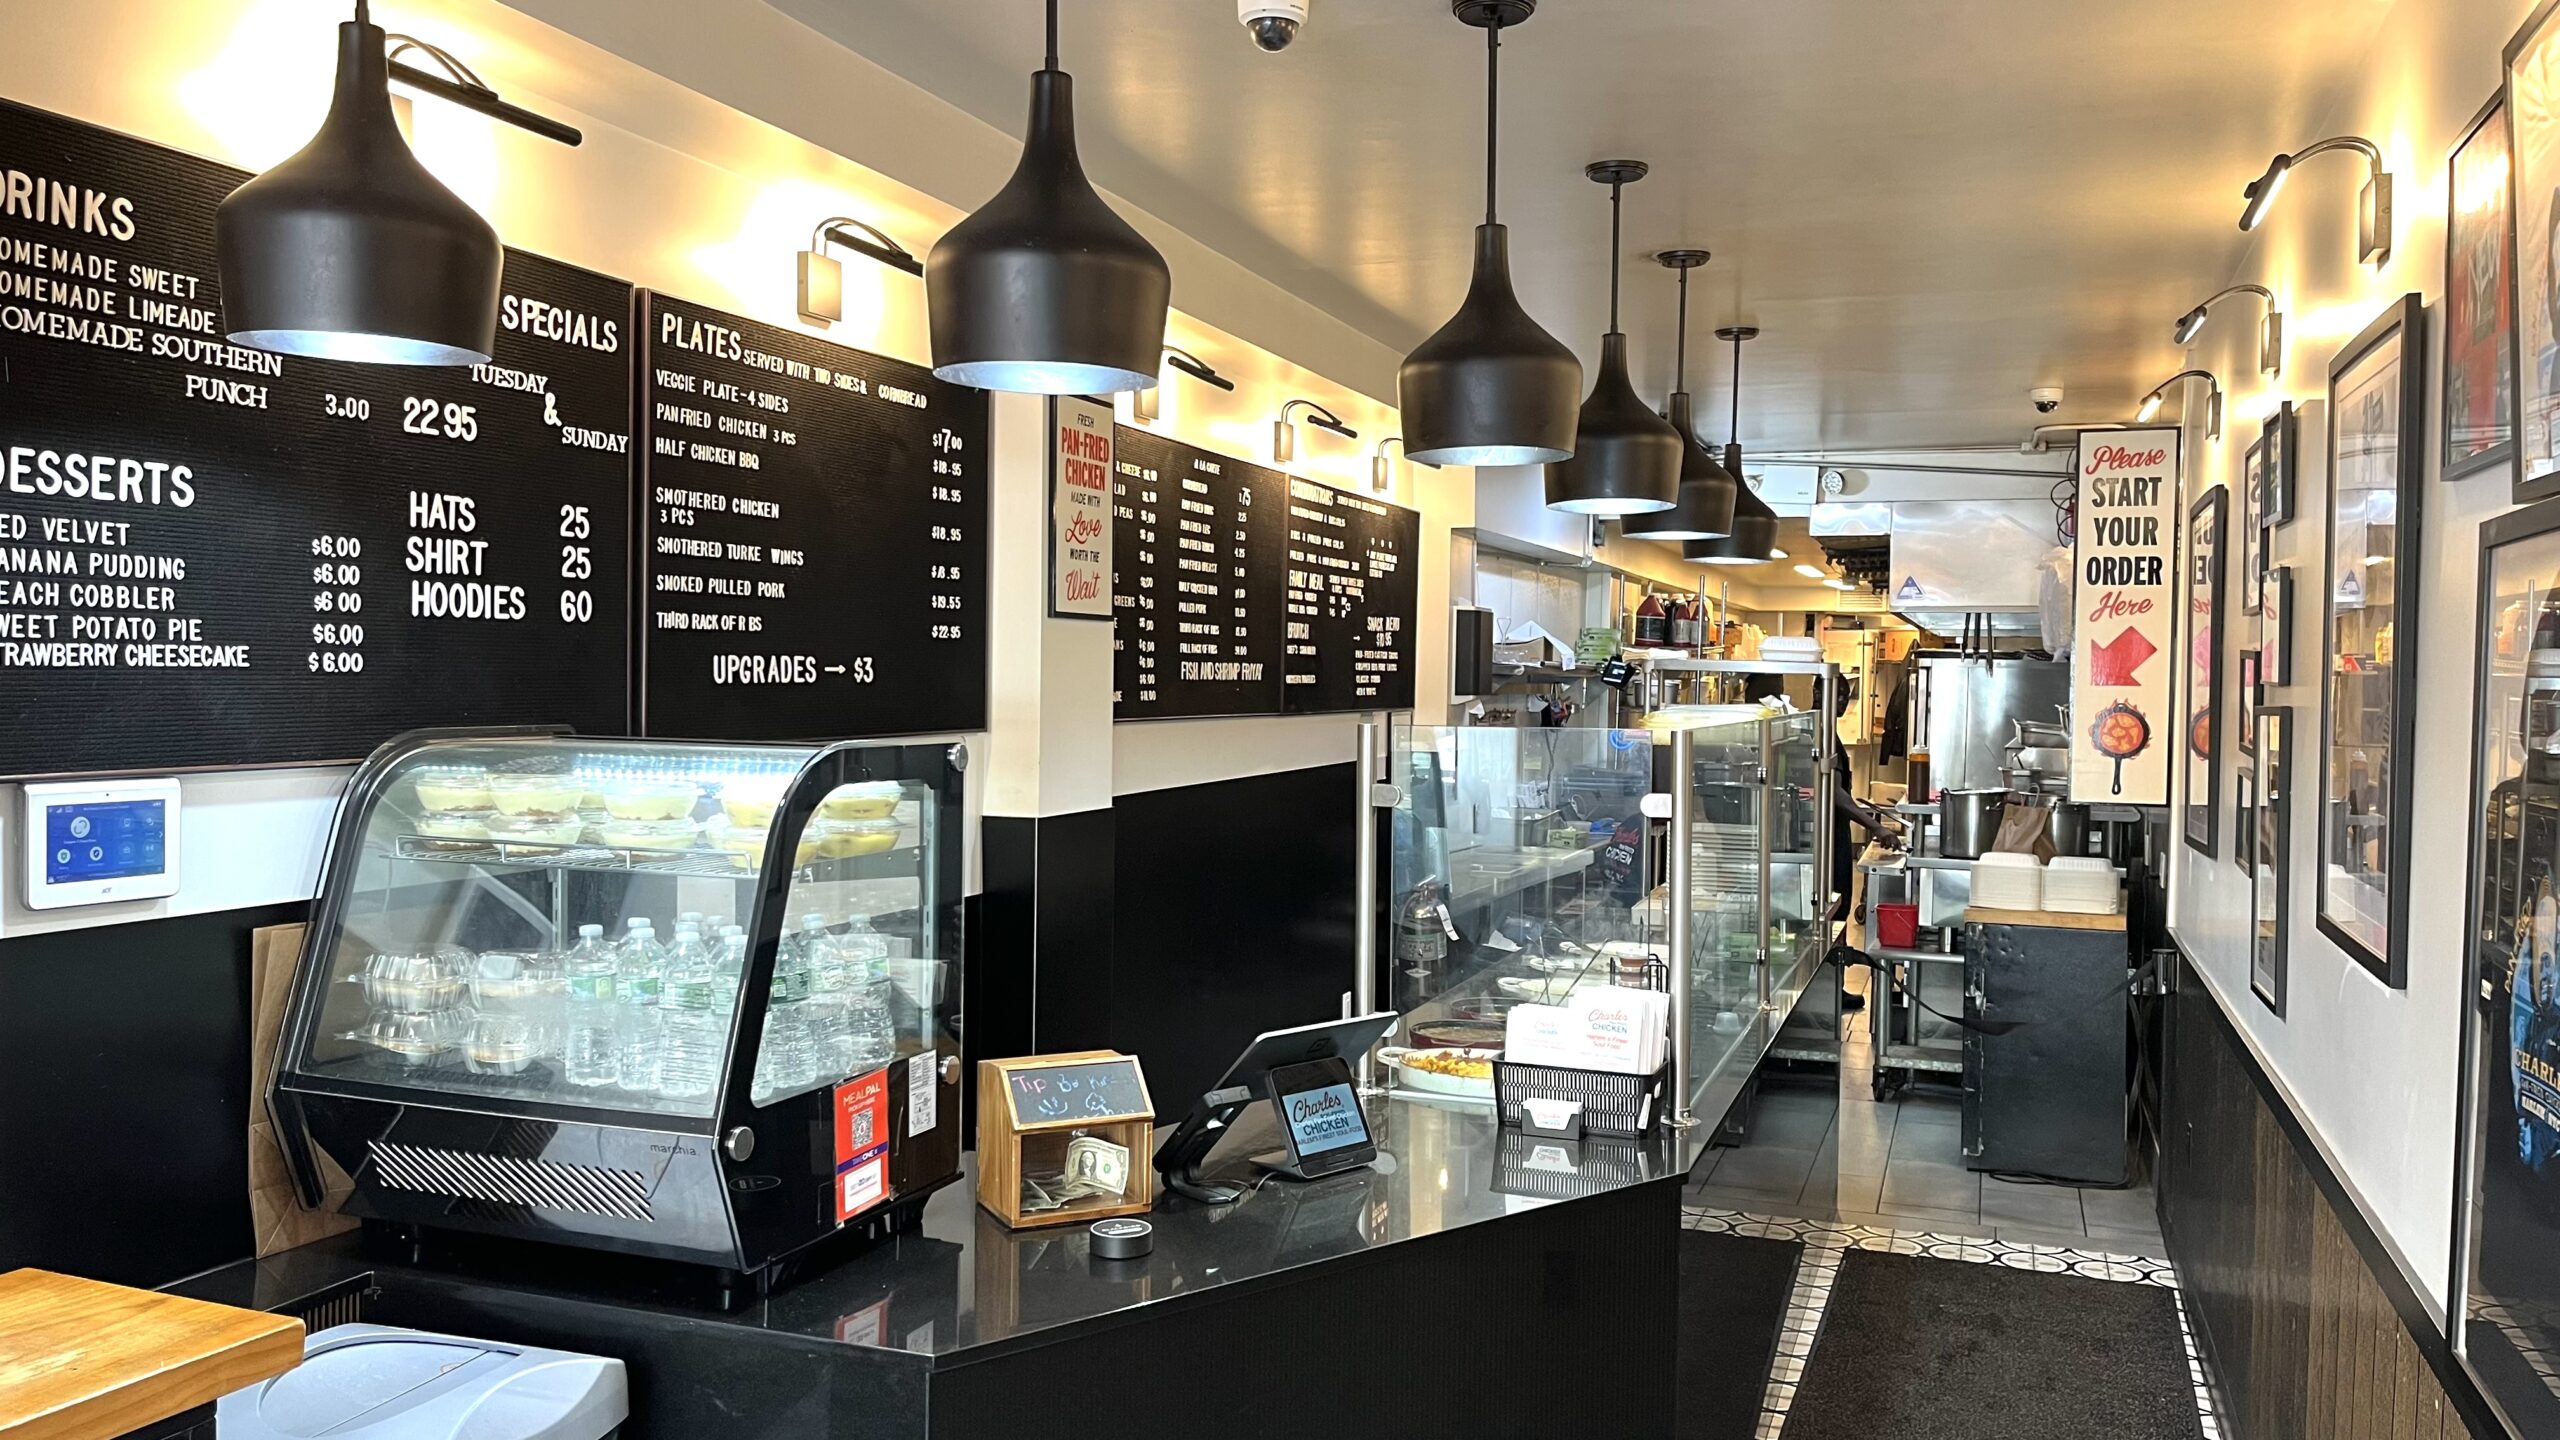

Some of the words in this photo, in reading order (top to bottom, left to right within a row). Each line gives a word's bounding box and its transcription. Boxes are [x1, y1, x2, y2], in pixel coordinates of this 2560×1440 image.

[0, 169, 136, 241] RINKS
[128, 264, 199, 300] SWEET
[128, 296, 216, 335] LIMEADE
[501, 294, 618, 353] SPECIALS
[0, 303, 144, 352] OMEMADE
[151, 333, 283, 377] SOUTHERN
[661, 313, 742, 361] PLATES
[743, 349, 784, 374] SERVED
[786, 359, 810, 381] WITH
[185, 374, 268, 409] PUNCH
[468, 362, 549, 395] TUESDAY
[656, 368, 696, 393] VEGGIE
[758, 392, 789, 414] SIDES
[325, 393, 370, 421] 3.00
[543, 392, 562, 427] &
[1077, 413, 1094, 428] FRESH
[561, 426, 629, 453] SUNDAY
[718, 415, 767, 440] CHICKEN
[773, 429, 780, 442] 3
[781, 430, 796, 445] PCS
[1061, 426, 1109, 464] PAN-FRIED
[655, 437, 686, 457] HALF
[690, 443, 736, 466] CHICKEN
[739, 453, 760, 470] BBQ
[2085, 445, 2167, 476] Please
[0, 446, 195, 508] ESSERTS
[1065, 457, 1105, 492] CHICKEN
[655, 487, 726, 511] SMOTHERED
[732, 501, 780, 519] CHICKEN
[1070, 491, 1086, 506] MADE
[1087, 492, 1100, 507] WITH
[2091, 477, 2163, 508] START
[409, 490, 476, 533] HATS
[560, 504, 590, 540] 25
[660, 509, 668, 524] 3
[671, 507, 695, 526] PCS
[1065, 510, 1102, 544] Love
[1119, 507, 1134, 520] PEAS
[42, 517, 131, 547] VELVET
[311, 535, 362, 558] $6.00
[2093, 516, 2159, 547] YOUR
[405, 536, 489, 576] SHIRT
[561, 545, 591, 580] 25
[657, 536, 722, 558] SMOTHERED
[726, 543, 762, 563] TURKE
[771, 548, 804, 566] WINGS
[1069, 548, 1089, 562] WORTH
[1089, 551, 1099, 563] THE
[89, 555, 186, 581] PUDDING
[312, 562, 361, 586] $6.00
[2086, 556, 2163, 586] ORDER
[70, 584, 175, 612] COBBLER
[655, 574, 703, 593] SMOKED
[708, 579, 751, 596] PULLED
[757, 581, 785, 598] PORK
[1065, 567, 1100, 601] Wait
[411, 580, 526, 620] HOODIES
[560, 590, 593, 622] 60
[1114, 595, 1136, 607] GREENS
[2089, 590, 2154, 623] Here
[72, 615, 156, 642] POTATO
[168, 618, 203, 642] PIE
[312, 624, 364, 647] $6.00
[656, 611, 689, 629] THIRD
[691, 613, 719, 631] RACK
[721, 614, 736, 631] OF
[125, 644, 250, 668] CHEESECAKE
[713, 655, 817, 684] UPGRADES
[853, 657, 874, 683] $3
[1181, 661, 1199, 680] FISH
[1200, 662, 1214, 680] AND
[1215, 662, 1240, 681] SHRIMP
[1592, 1022, 1628, 1034] CHICKEN
[842, 1082, 881, 1107] MEALPAL
[1011, 1075, 1047, 1093] Tip
[1293, 1091, 1342, 1123] Charles
[1303, 1117, 1349, 1136] CHICKEN
[651, 1143, 697, 1156] marchia
